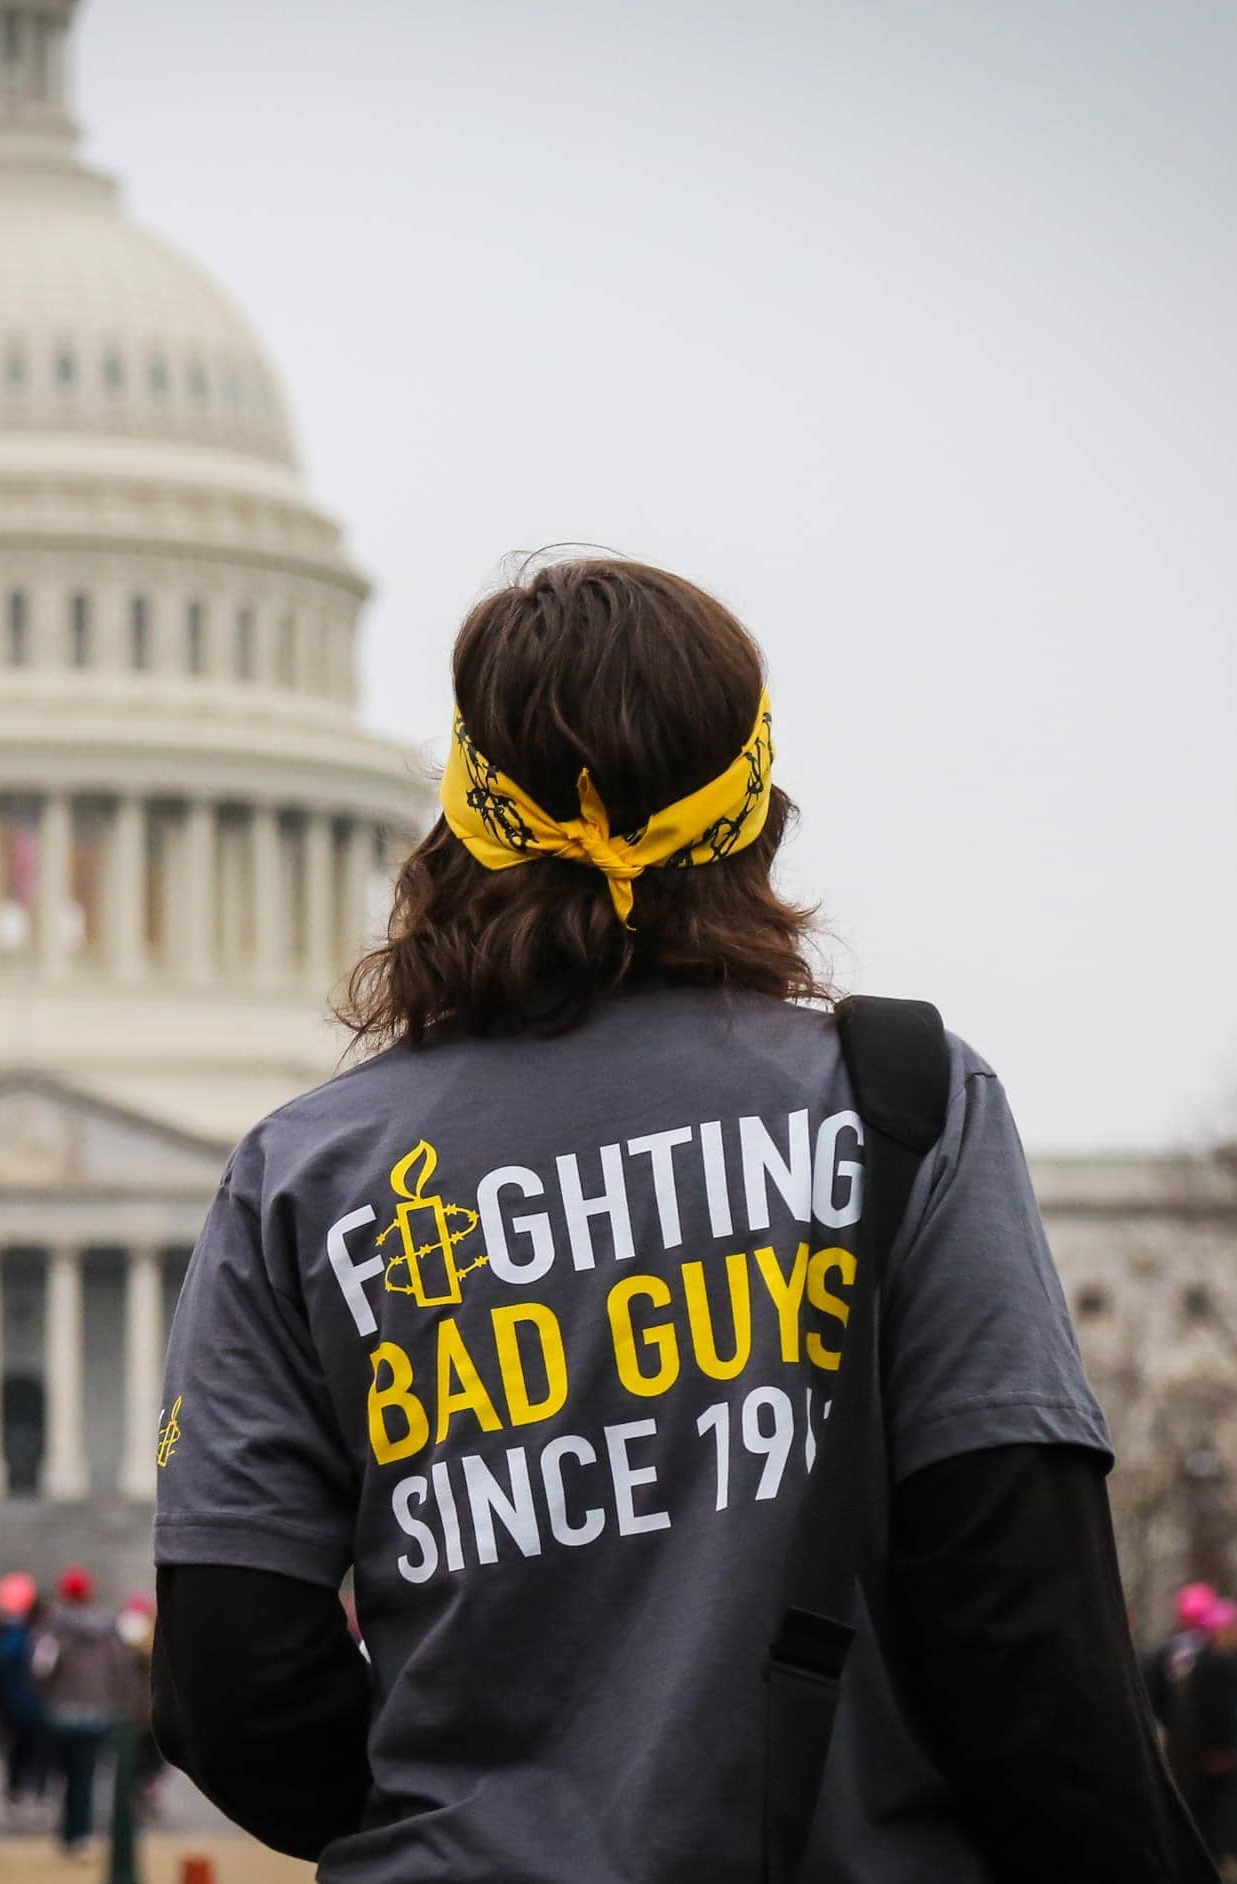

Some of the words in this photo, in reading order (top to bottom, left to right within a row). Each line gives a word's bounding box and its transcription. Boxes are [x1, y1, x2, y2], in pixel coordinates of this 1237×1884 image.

[367, 1302, 568, 1466] BAD
[606, 1241, 858, 1397] GUYS
[391, 1418, 672, 1584] SINCE
[695, 1385, 833, 1512] 19
